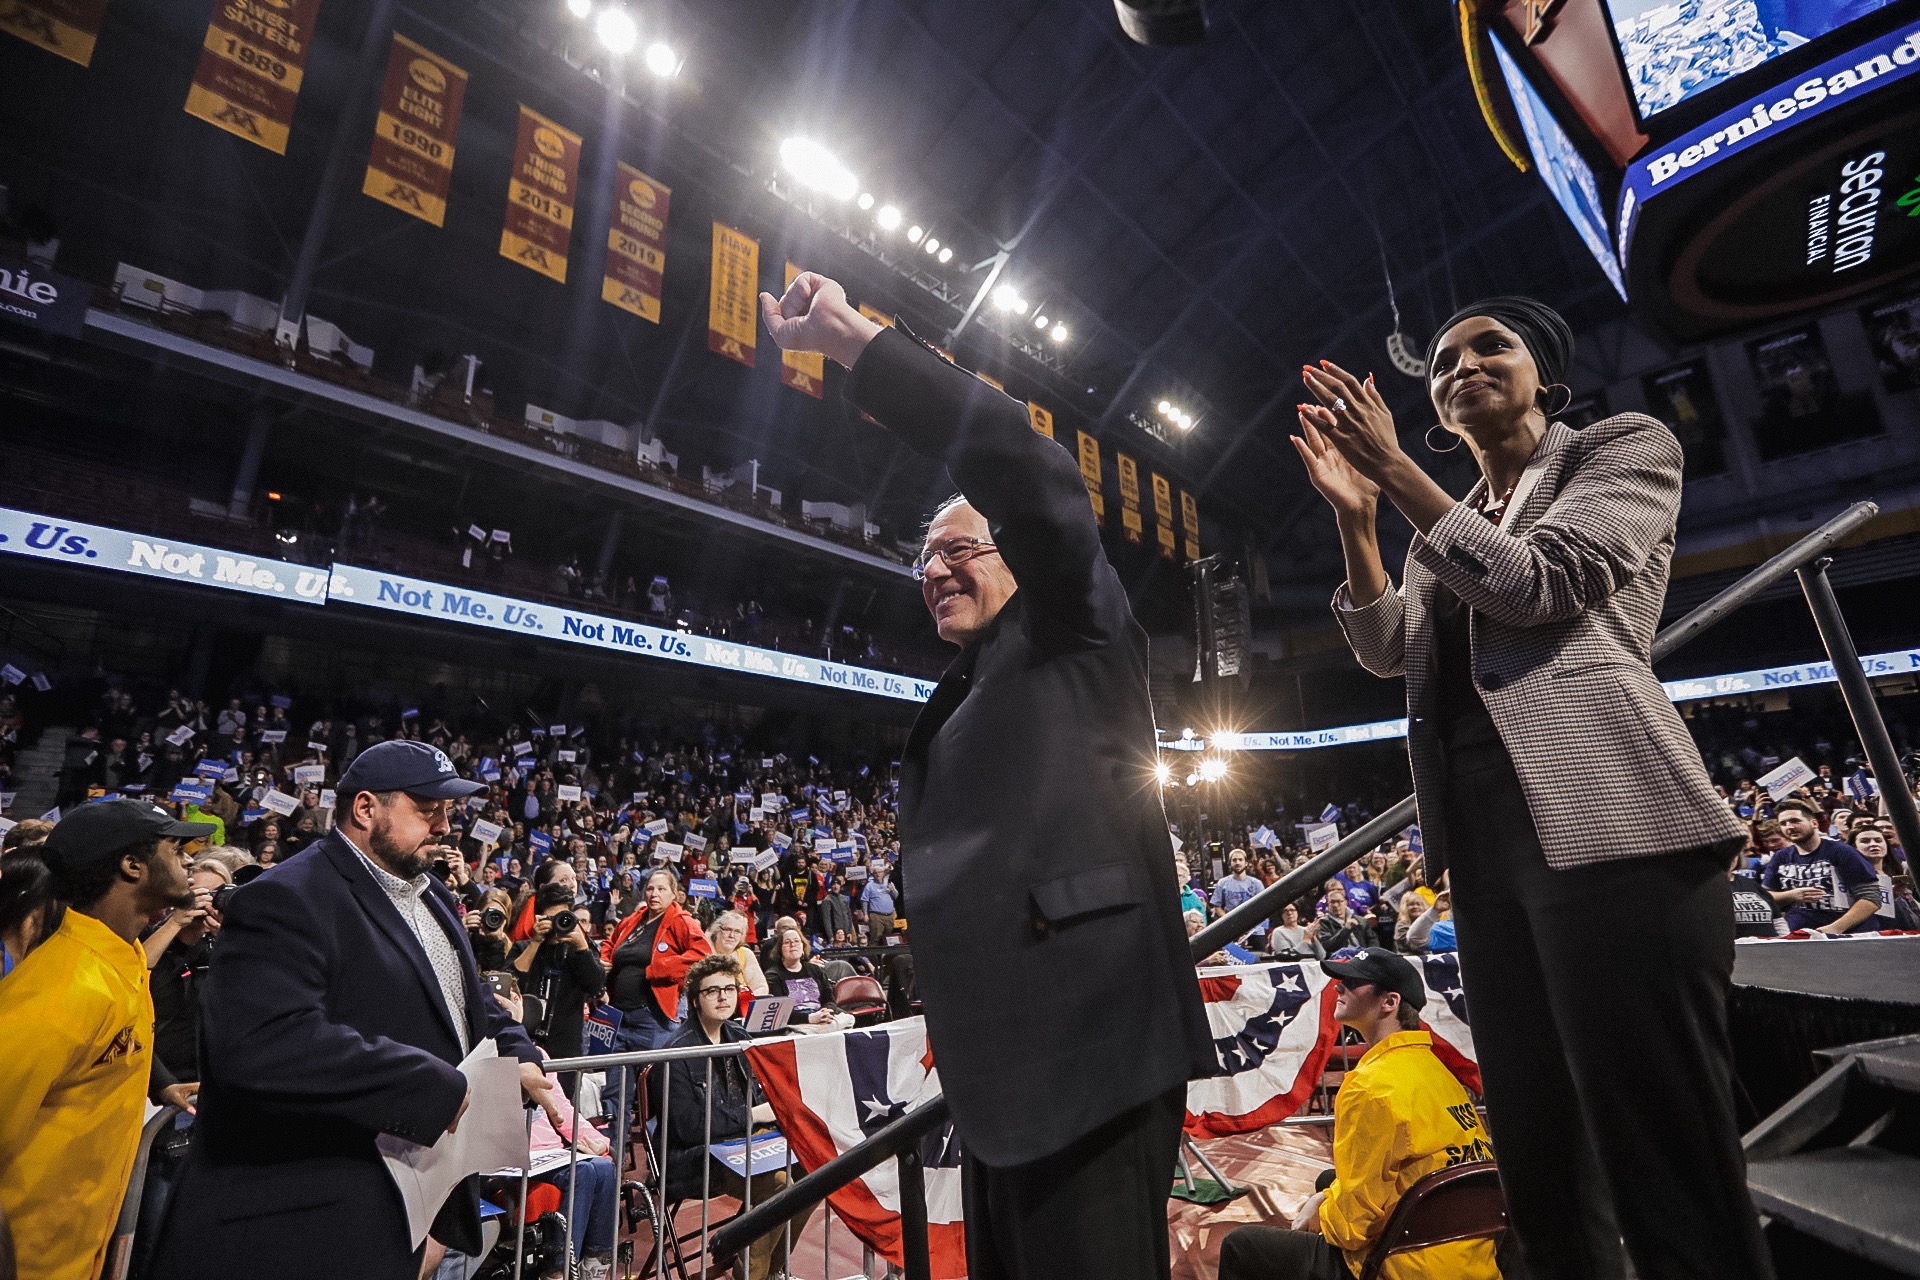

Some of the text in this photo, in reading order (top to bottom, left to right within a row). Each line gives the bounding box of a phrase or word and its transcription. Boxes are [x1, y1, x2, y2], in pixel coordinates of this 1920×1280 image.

[223, 5, 301, 54] SIXTEEN
[225, 38, 287, 81] 1989
[399, 96, 444, 129] EIGHT
[403, 85, 444, 116] ELITE
[392, 123, 443, 159] 1990
[528, 152, 566, 181] THIRD
[519, 188, 563, 220] 2013
[1832, 151, 1886, 273] securian
[1806, 194, 1831, 265] FINANCIAL
[618, 236, 657, 265] 2019
[24, 522, 98, 558] Us.
[127, 540, 354, 599] Not Me. Us.
[377, 579, 544, 630] Not Me. Us.
[562, 615, 692, 657] Not Me. Us.
[704, 642, 740, 667] Not
[819, 665, 906, 695] Not Me. Us.
[914, 683, 936, 699] No
[1763, 672, 1802, 687] Not
[1269, 733, 1338, 746] Not Me. Us.
[1766, 765, 1805, 792] Bernie
[761, 1002, 780, 1031] rnie
